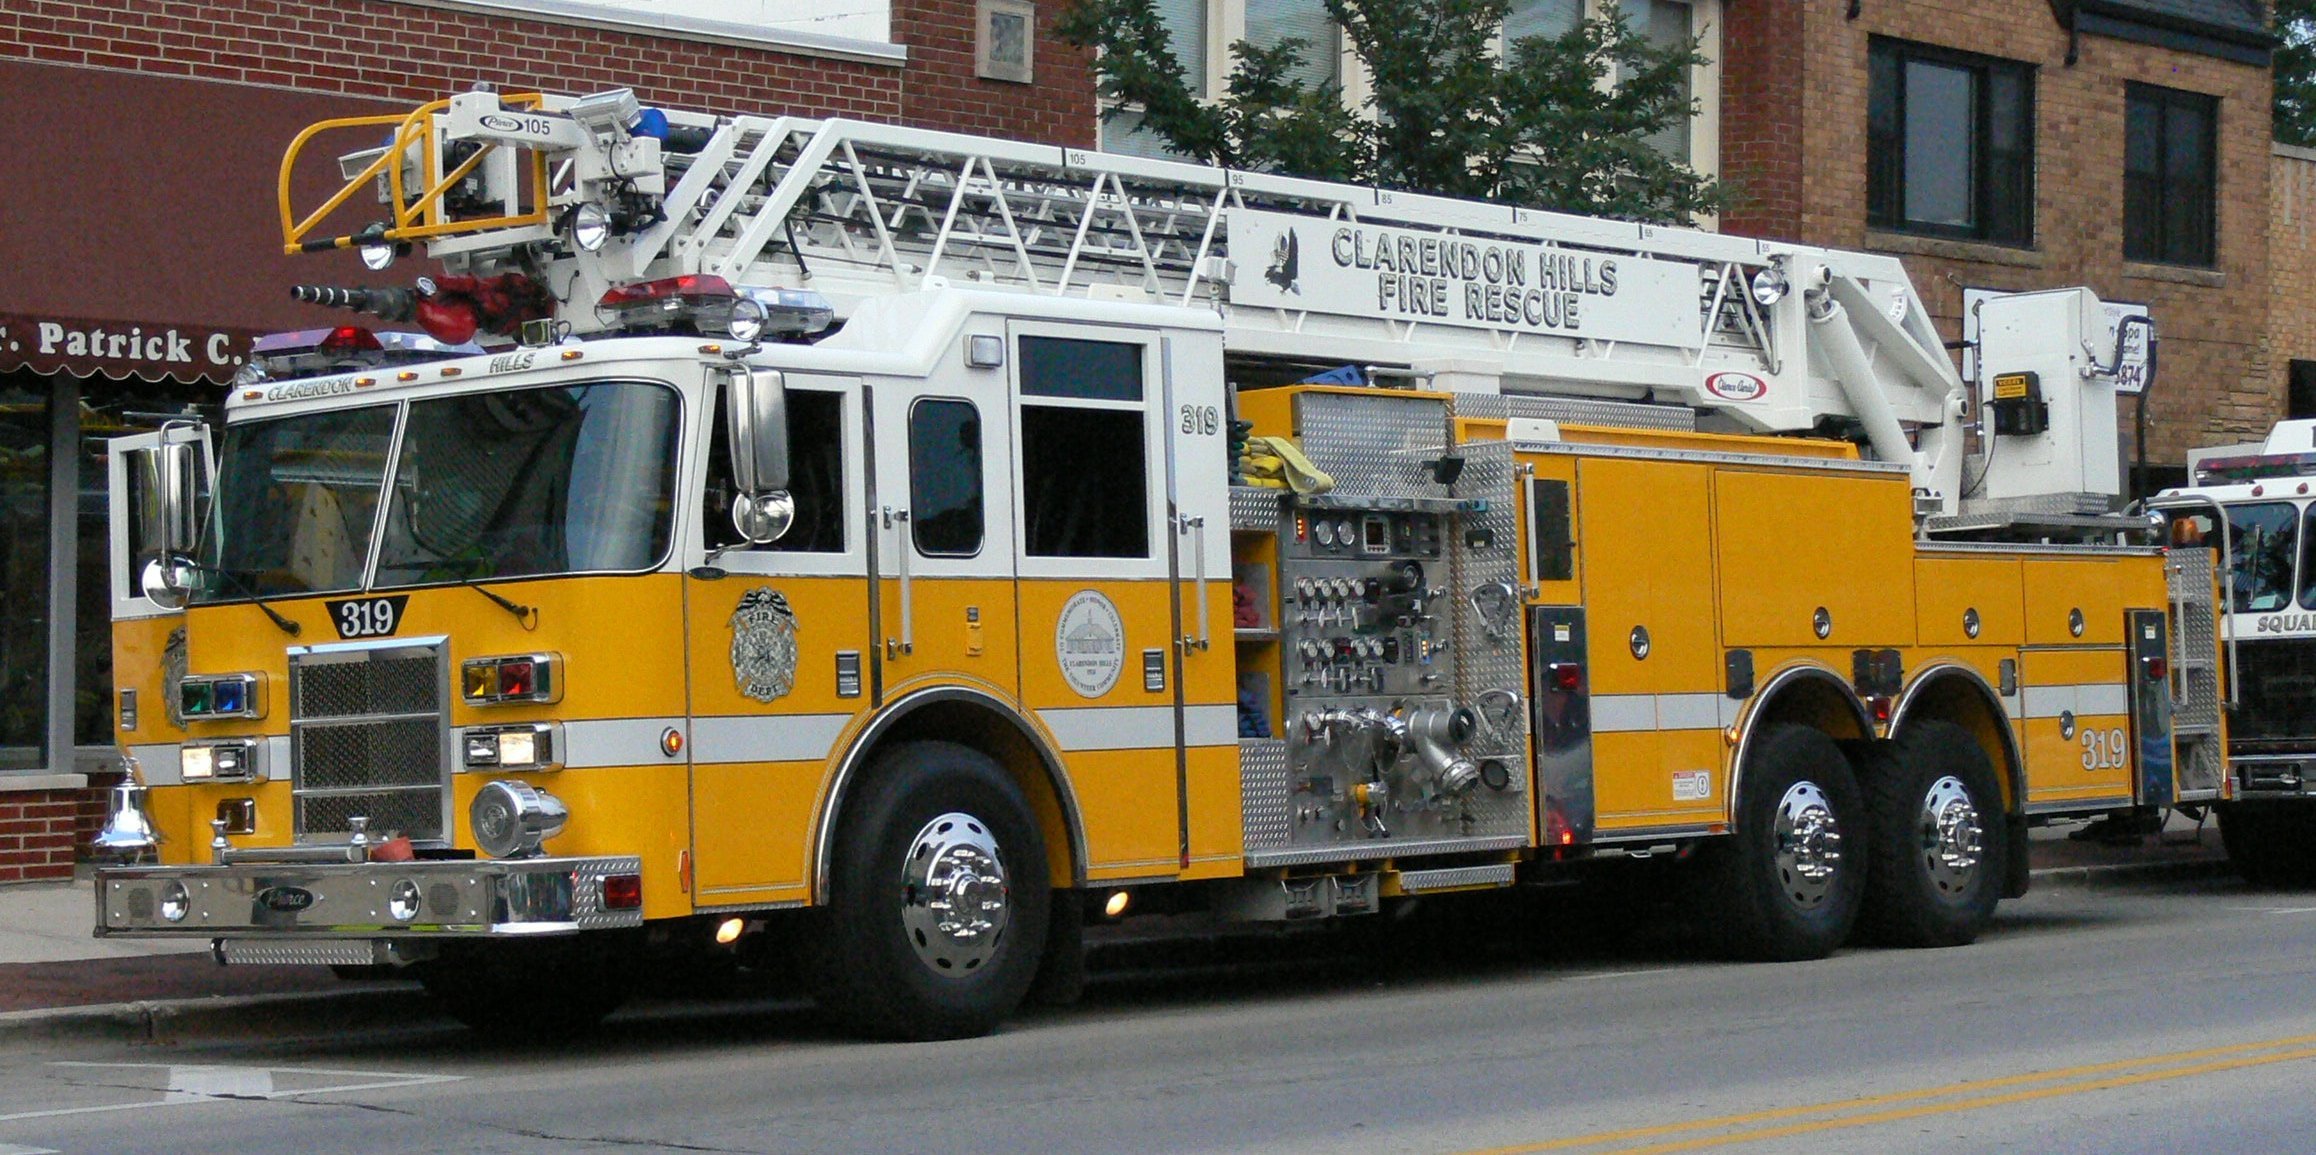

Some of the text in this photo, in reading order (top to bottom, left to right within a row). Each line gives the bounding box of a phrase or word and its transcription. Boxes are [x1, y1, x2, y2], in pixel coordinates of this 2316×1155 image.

[524, 119, 550, 135] 105
[1070, 153, 1086, 165] 105
[1232, 174, 1244, 185] 95
[1381, 193, 1393, 205] 85
[1519, 211, 1528, 222] 75
[1331, 227, 1618, 297] CLARENDON HILLS
[1378, 272, 1580, 330] FIRE RESCUE
[38, 322, 192, 363] Patrick
[206, 333, 243, 366] C.
[267, 352, 536, 402] CLARENDON HILLS
[1181, 404, 1219, 436] 319
[341, 599, 394, 638] 319
[748, 610, 778, 626] FIRE
[2081, 728, 2126, 771] 319
